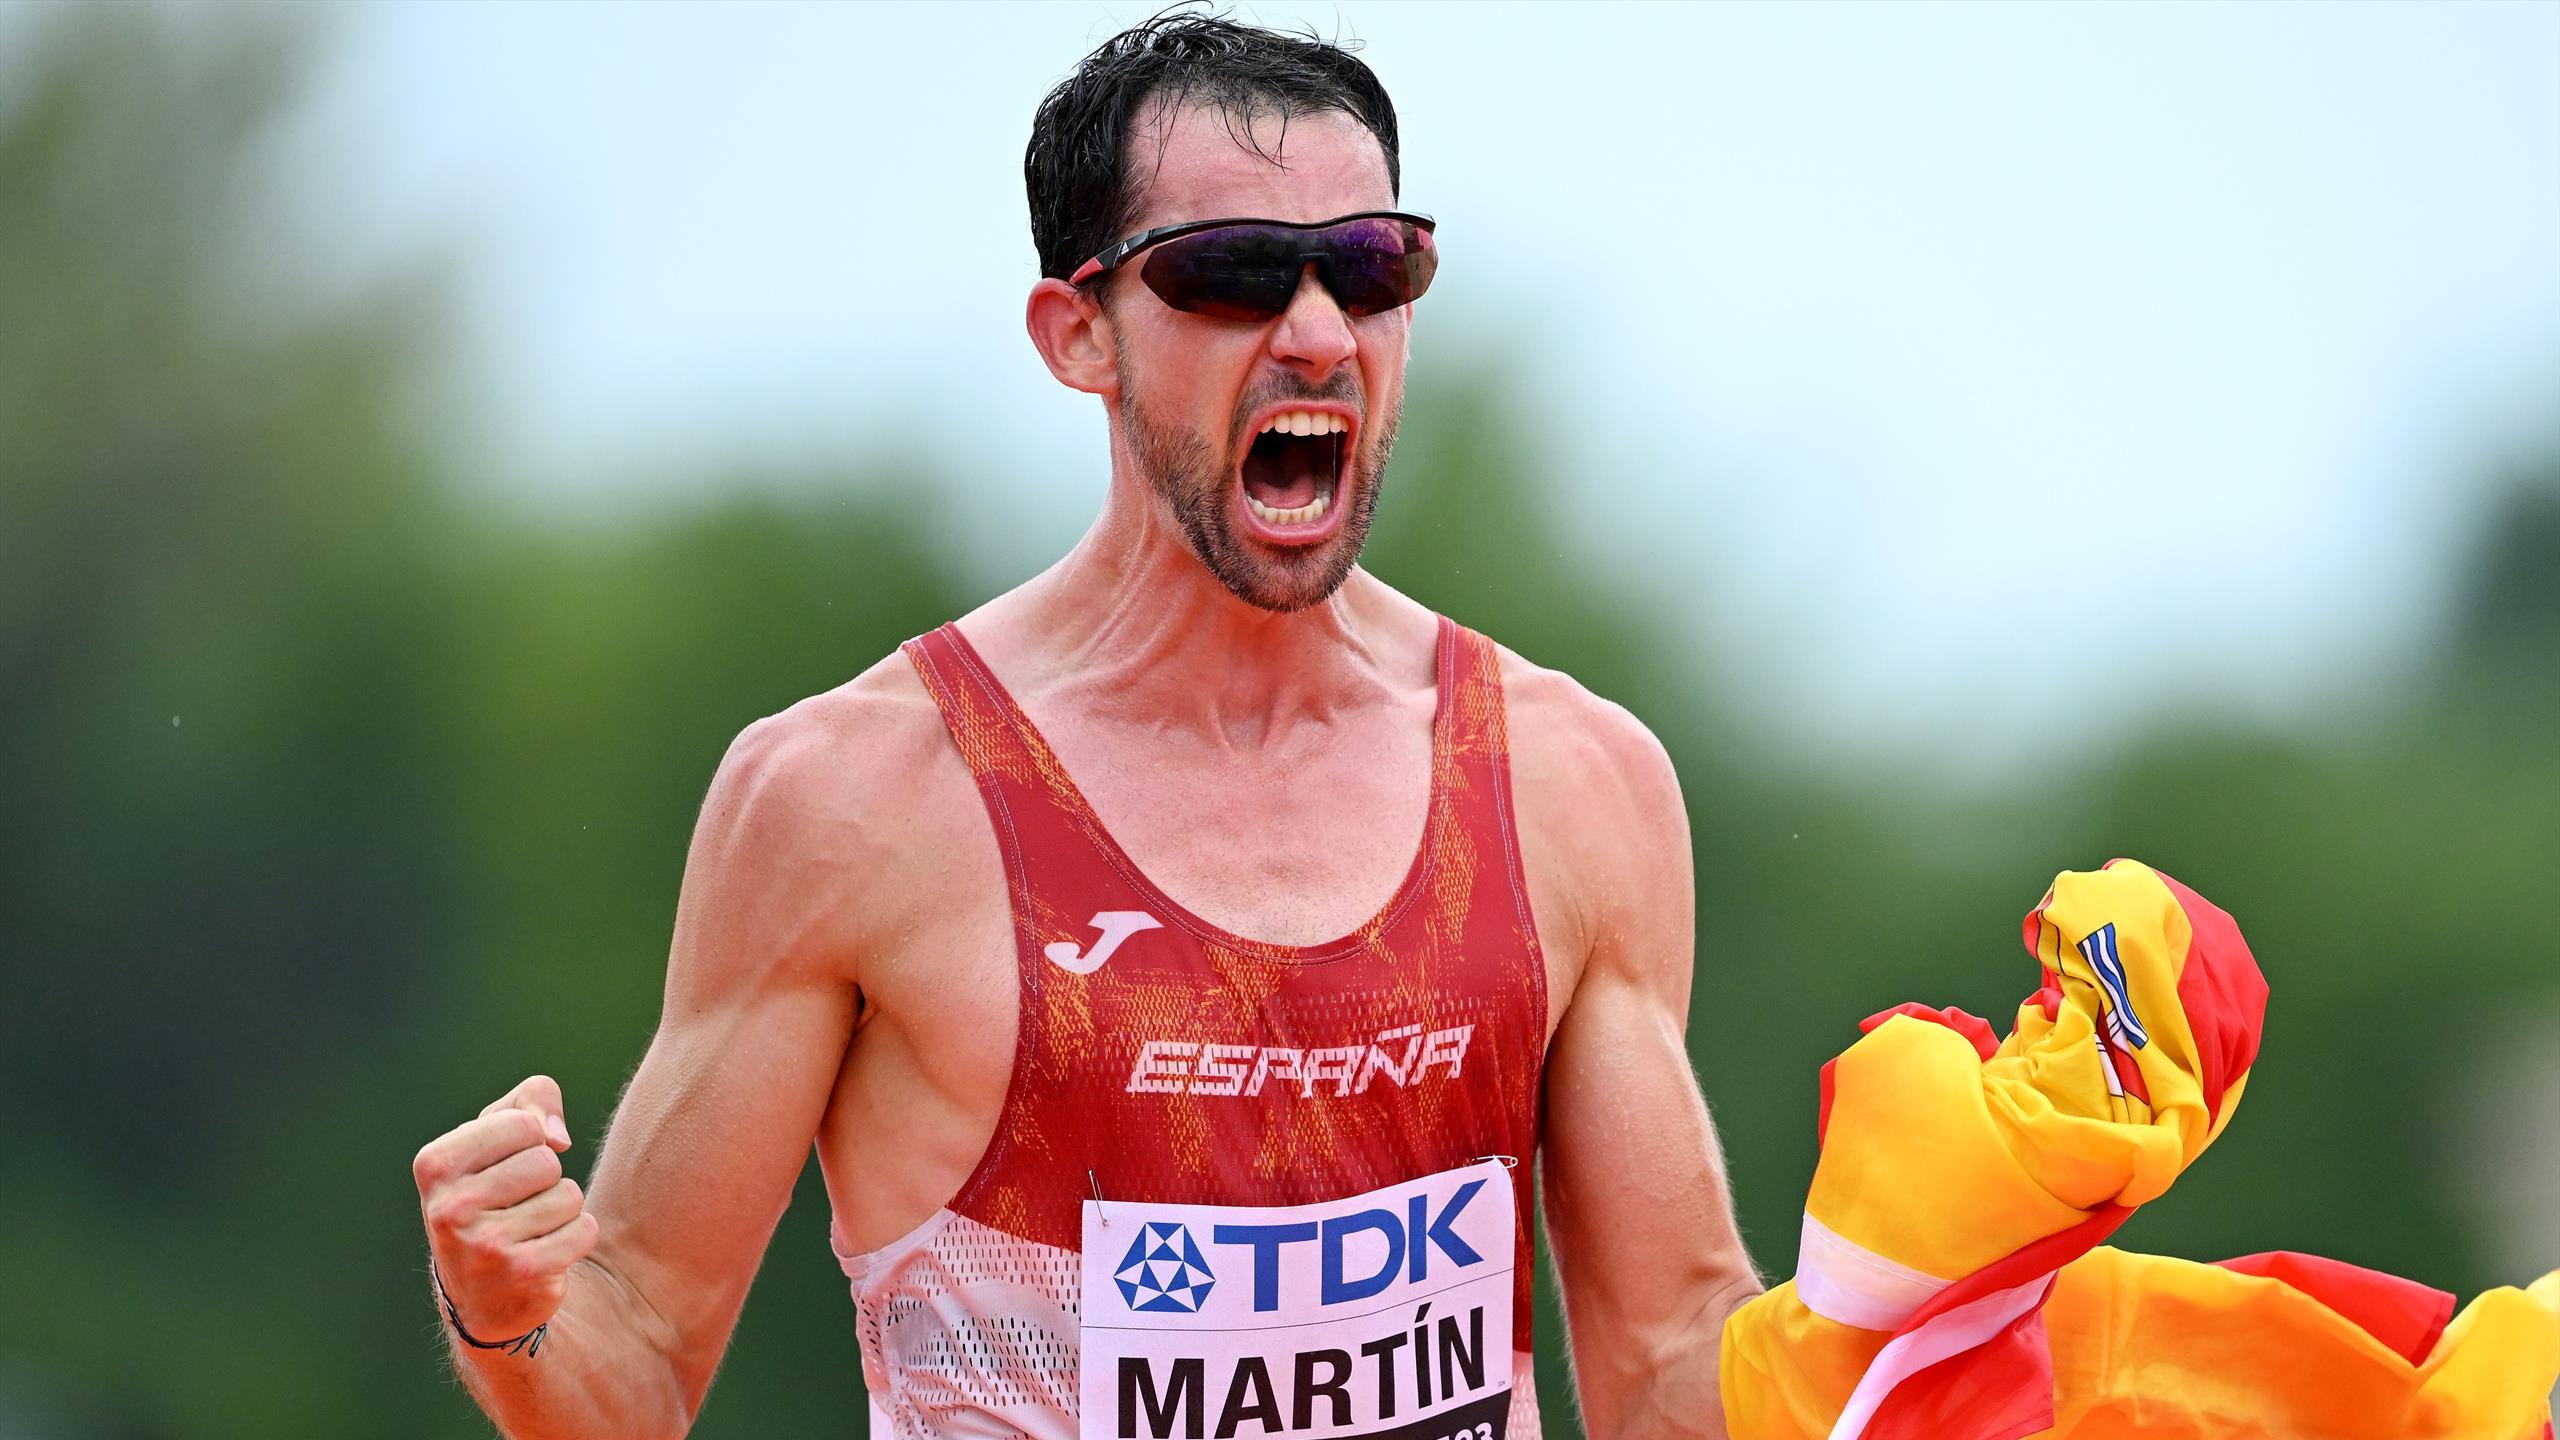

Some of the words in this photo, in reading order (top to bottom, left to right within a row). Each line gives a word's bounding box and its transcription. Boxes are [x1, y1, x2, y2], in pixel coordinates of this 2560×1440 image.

[1126, 1024, 1475, 1098] ESPAÑA
[1213, 1178, 1488, 1312] TDK
[1117, 1302, 1485, 1439] MARTÍN
